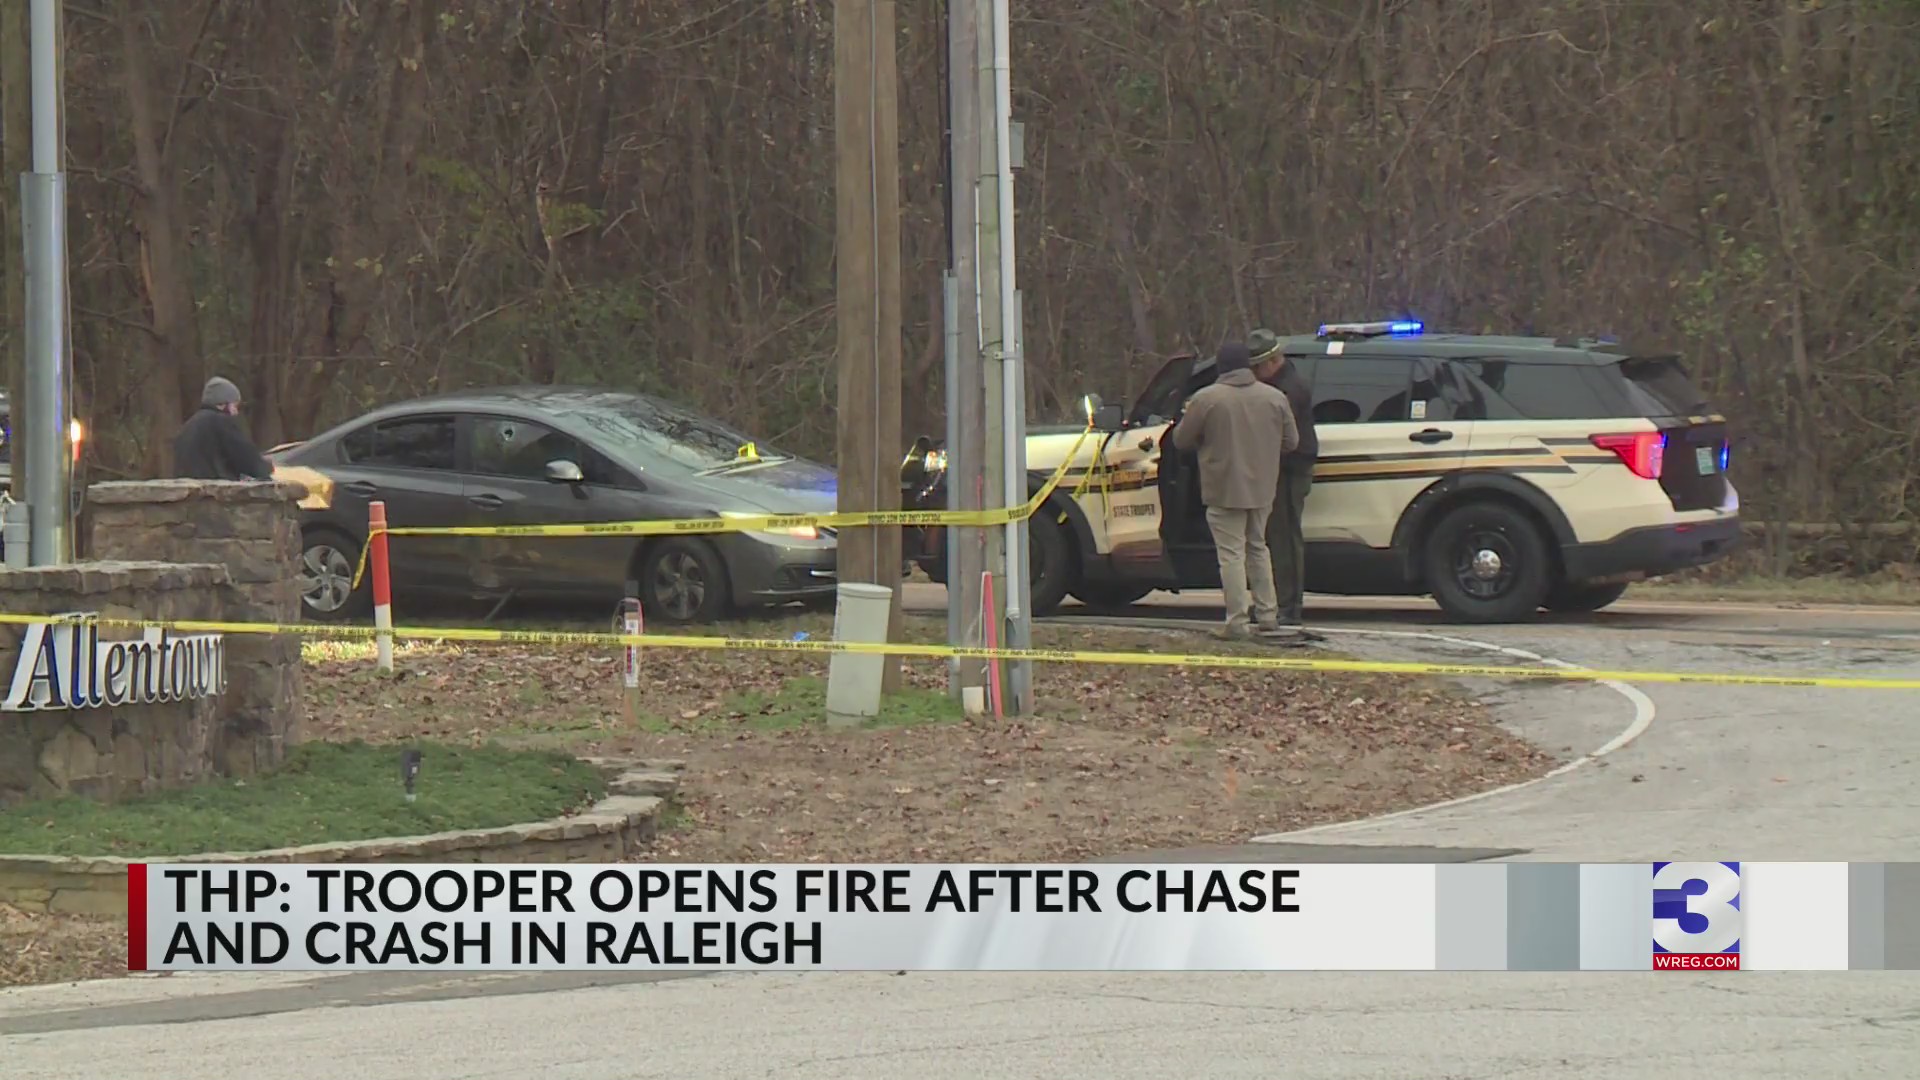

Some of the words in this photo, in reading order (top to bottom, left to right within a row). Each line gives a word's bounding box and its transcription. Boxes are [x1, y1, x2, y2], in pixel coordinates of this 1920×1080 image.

[1113, 505, 1131, 518] STATE
[1130, 503, 1156, 516] TROOPER
[2, 612, 228, 711] Allentown
